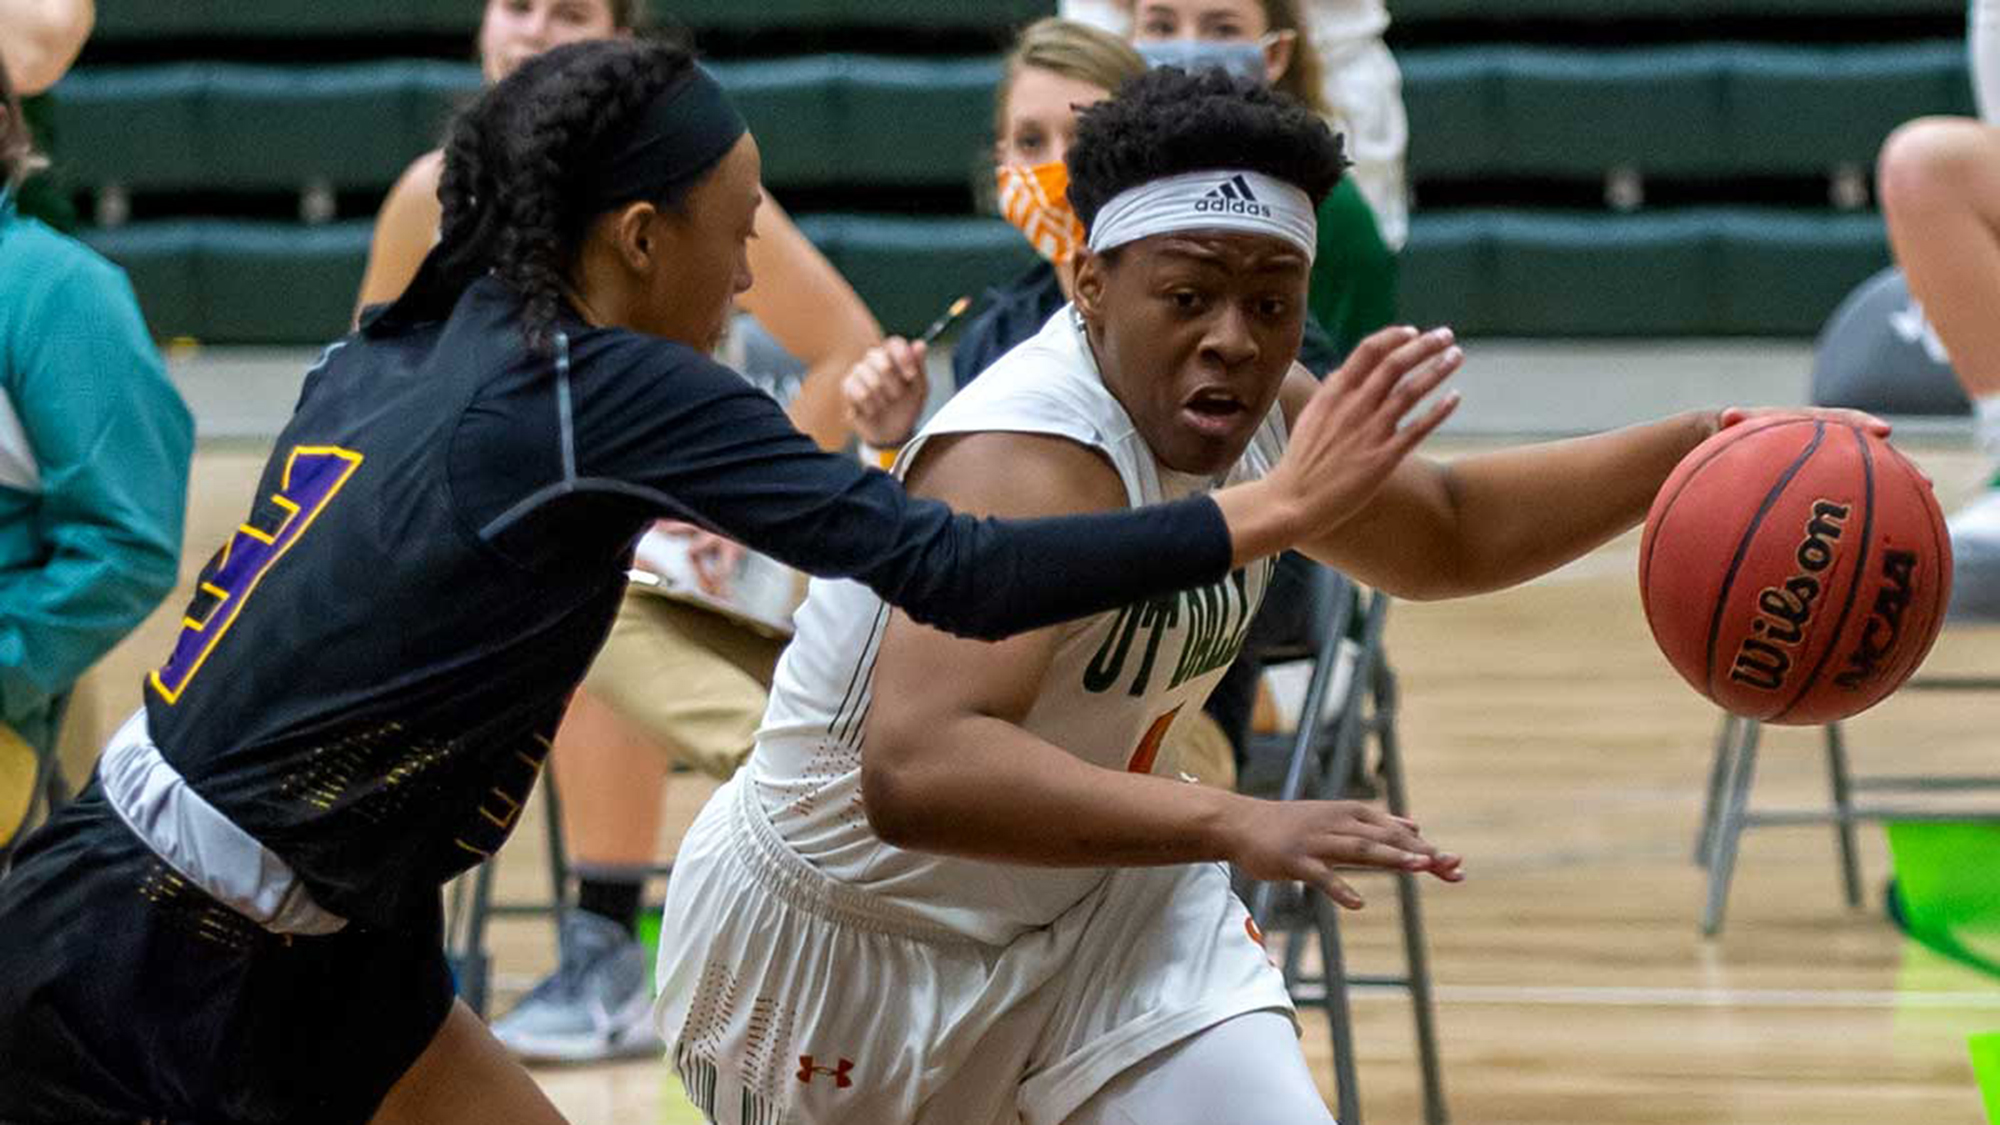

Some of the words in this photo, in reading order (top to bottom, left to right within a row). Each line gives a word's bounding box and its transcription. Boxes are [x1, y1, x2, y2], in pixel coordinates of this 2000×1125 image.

[1194, 197, 1272, 218] adidas
[1082, 594, 1180, 698] UT
[1727, 498, 1851, 691] Wilson
[1833, 549, 1918, 690] NCAA
